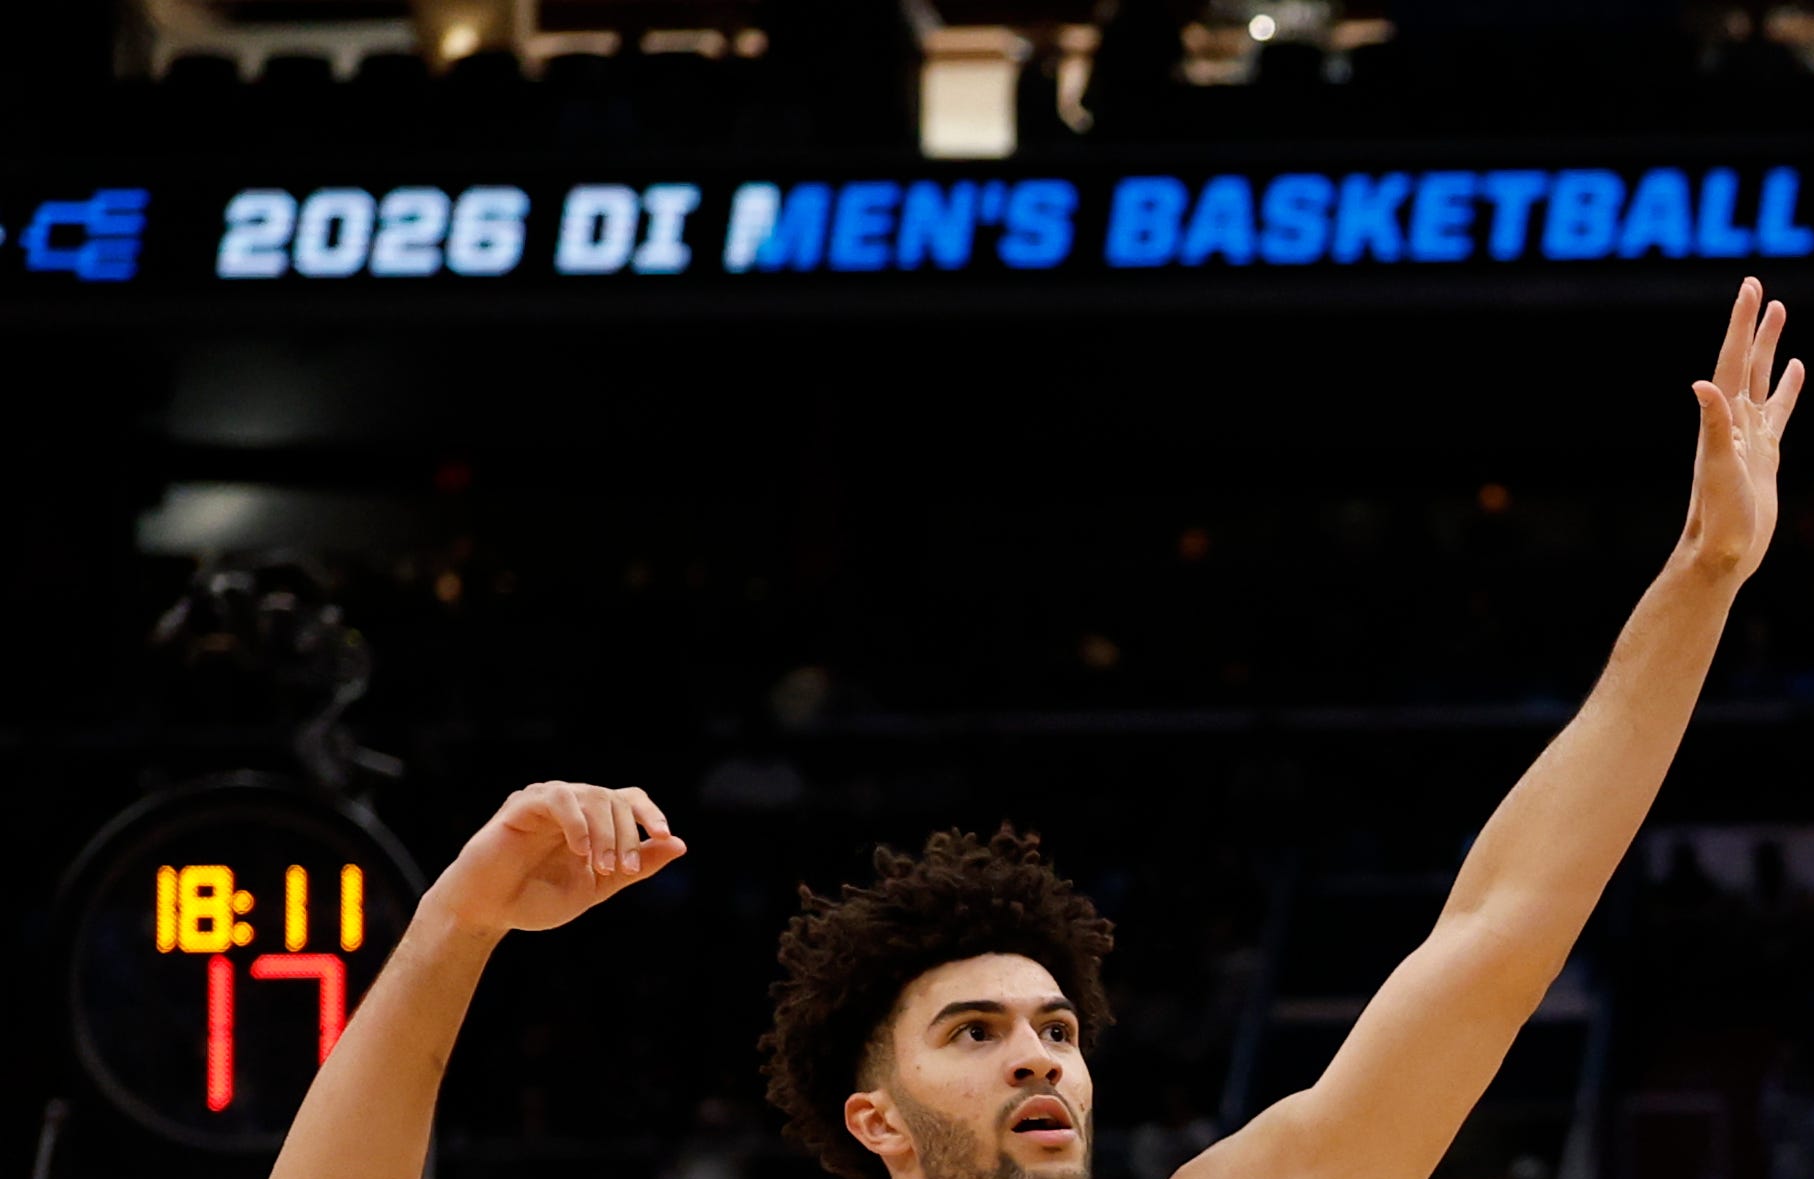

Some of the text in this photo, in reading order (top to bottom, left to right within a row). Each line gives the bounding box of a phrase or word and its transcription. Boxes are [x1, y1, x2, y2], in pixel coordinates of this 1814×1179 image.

[216, 186, 532, 279] 2026
[555, 183, 702, 275] DI
[723, 179, 1079, 273] MEN'S
[157, 864, 363, 953] 18:11
[207, 953, 347, 1112] 17
